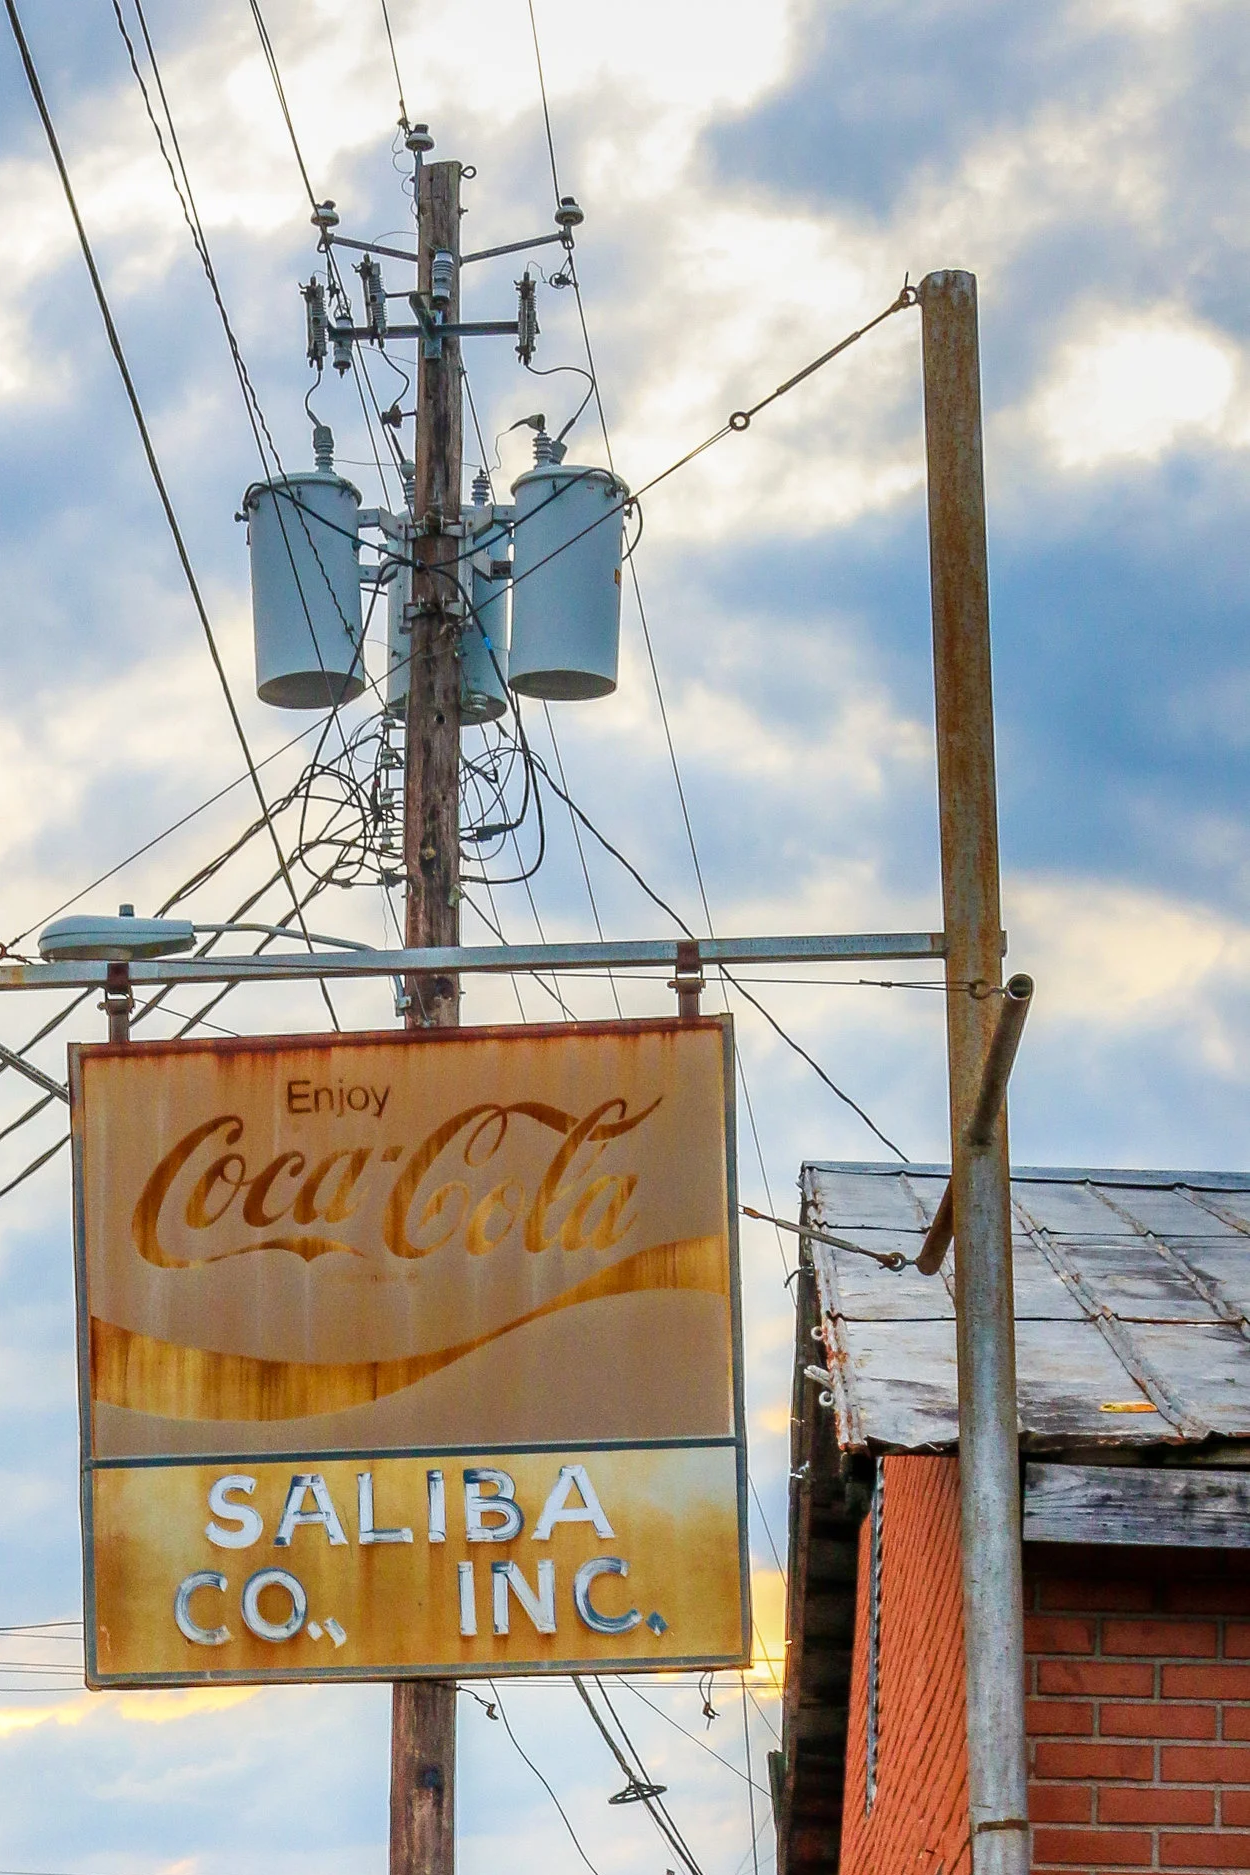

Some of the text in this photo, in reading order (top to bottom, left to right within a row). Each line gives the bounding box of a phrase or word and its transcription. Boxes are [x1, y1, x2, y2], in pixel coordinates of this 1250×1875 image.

[286, 1079, 390, 1118] Enjoy
[131, 1097, 663, 1269] Coca-Cola
[205, 1465, 616, 1549] SALIBA
[457, 1556, 669, 1637] INC.
